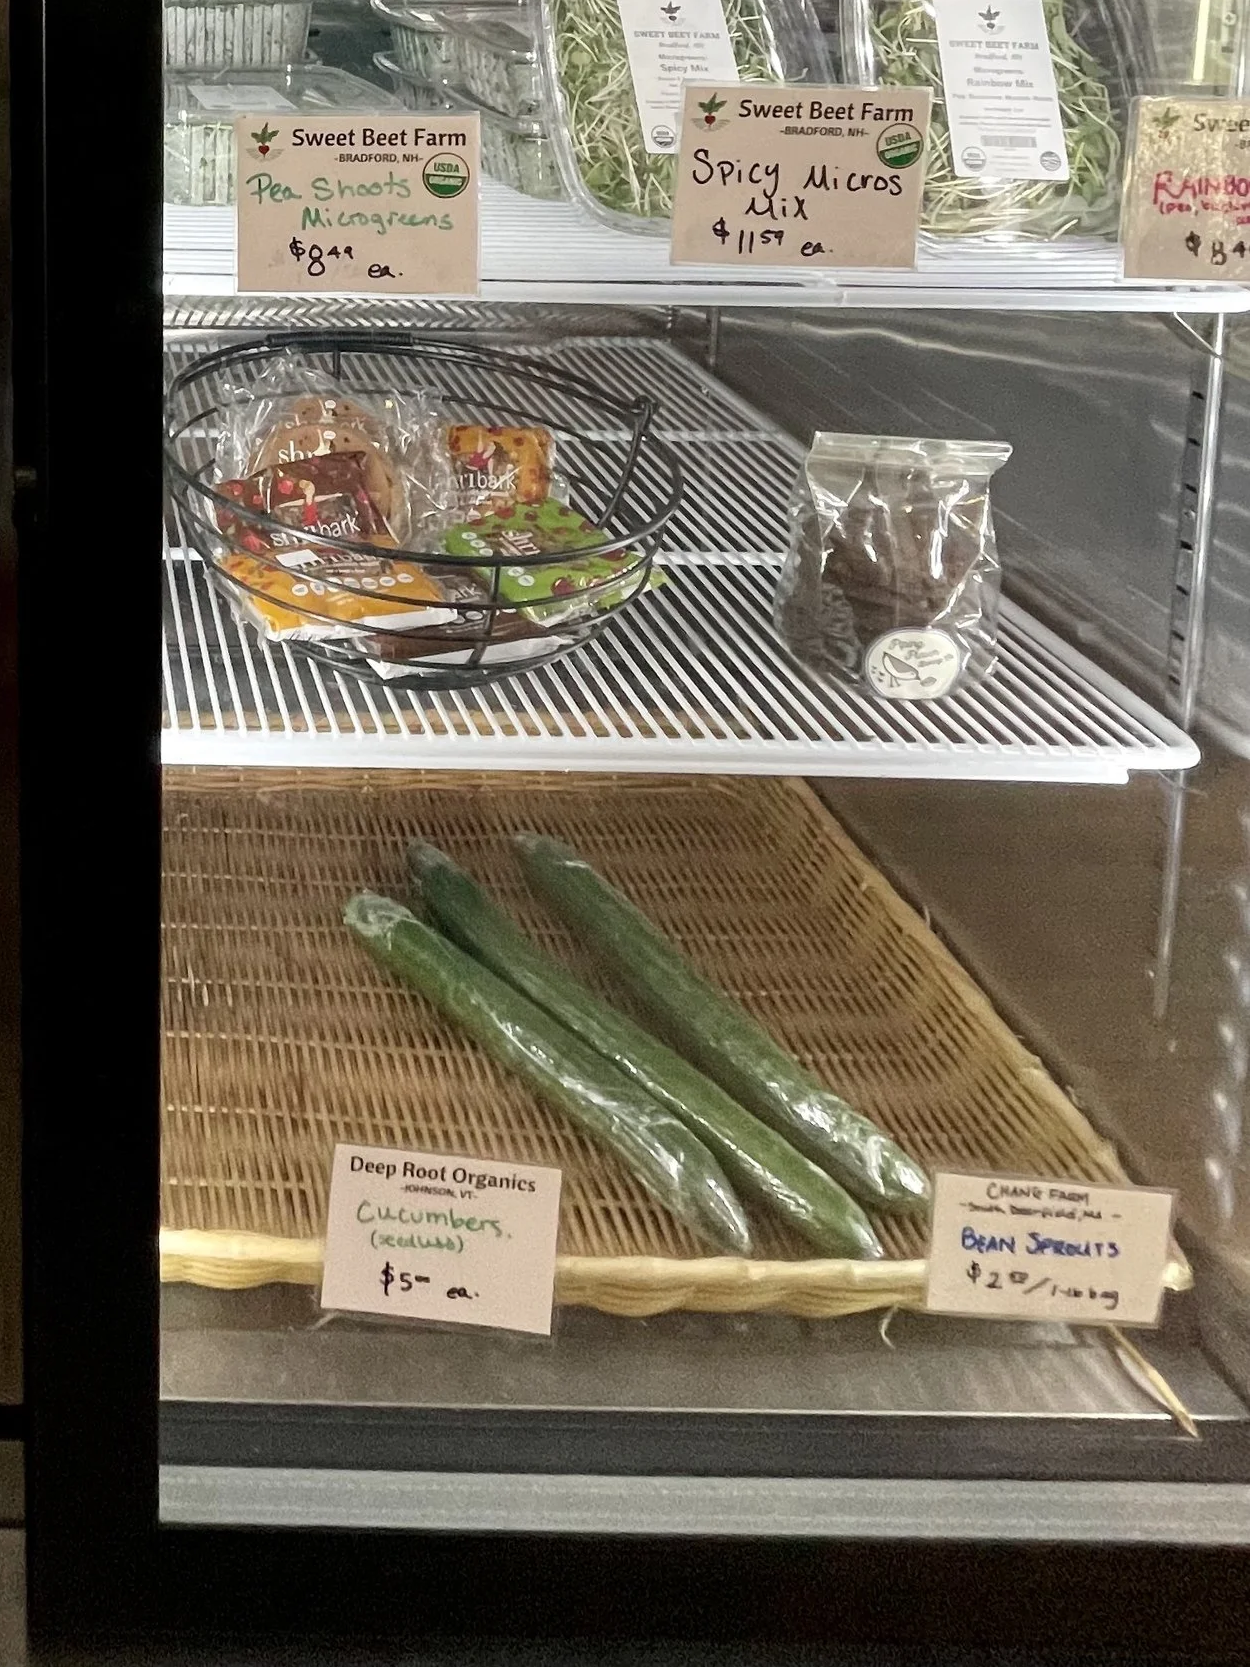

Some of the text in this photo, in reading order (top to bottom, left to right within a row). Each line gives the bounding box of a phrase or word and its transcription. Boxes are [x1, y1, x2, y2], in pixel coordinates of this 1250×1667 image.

[660, 64, 709, 73] Spicy Mix
[967, 78, 1034, 88] Rainbow Mix
[738, 99, 914, 122] Sweet Beet Farm
[292, 128, 467, 147] Sweet Beet Farm
[433, 162, 460, 173] USDA
[692, 148, 903, 197] Spicy Micros
[246, 171, 411, 204] Pea Shoots
[744, 196, 809, 221] Mix
[302, 206, 454, 235] Microgreens
[801, 241, 834, 257] ea.
[367, 264, 403, 278] ea.
[350, 1155, 536, 1192] Deep Root Organics
[961, 1226, 1120, 1258] BEAN SPROUTS
[446, 1286, 480, 1299] ea.
